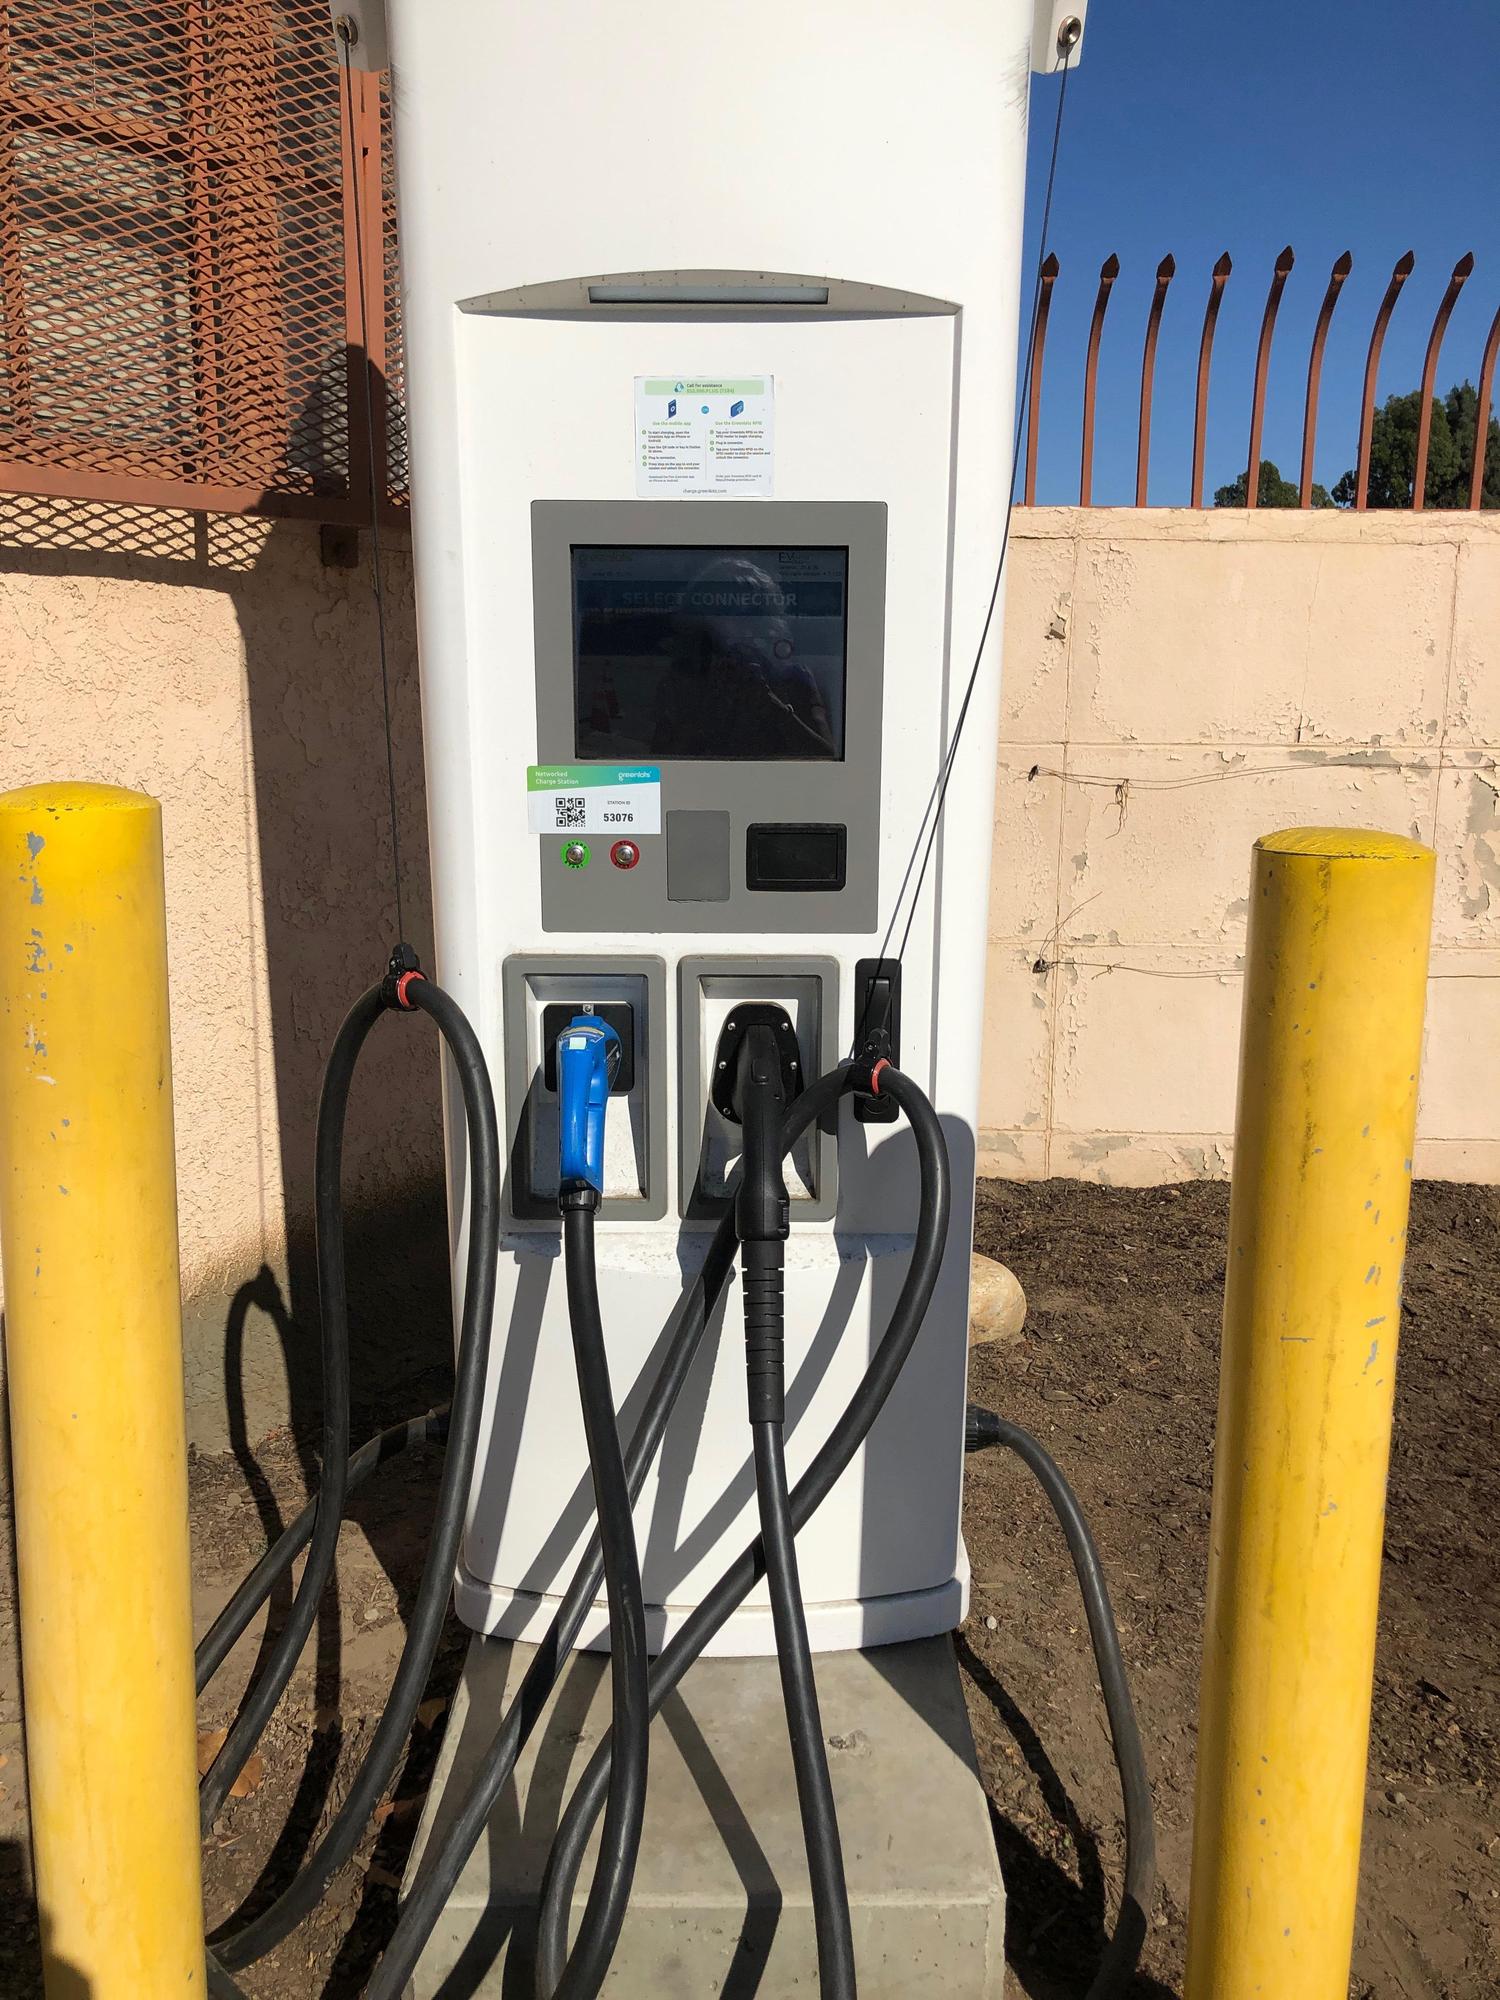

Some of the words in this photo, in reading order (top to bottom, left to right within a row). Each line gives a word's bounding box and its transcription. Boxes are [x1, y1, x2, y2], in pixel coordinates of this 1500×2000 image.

[622, 592, 688, 606] SELECT
[692, 592, 797, 606] CONNECTOR
[618, 771, 651, 781] greenlots
[603, 814, 634, 822] 53076
